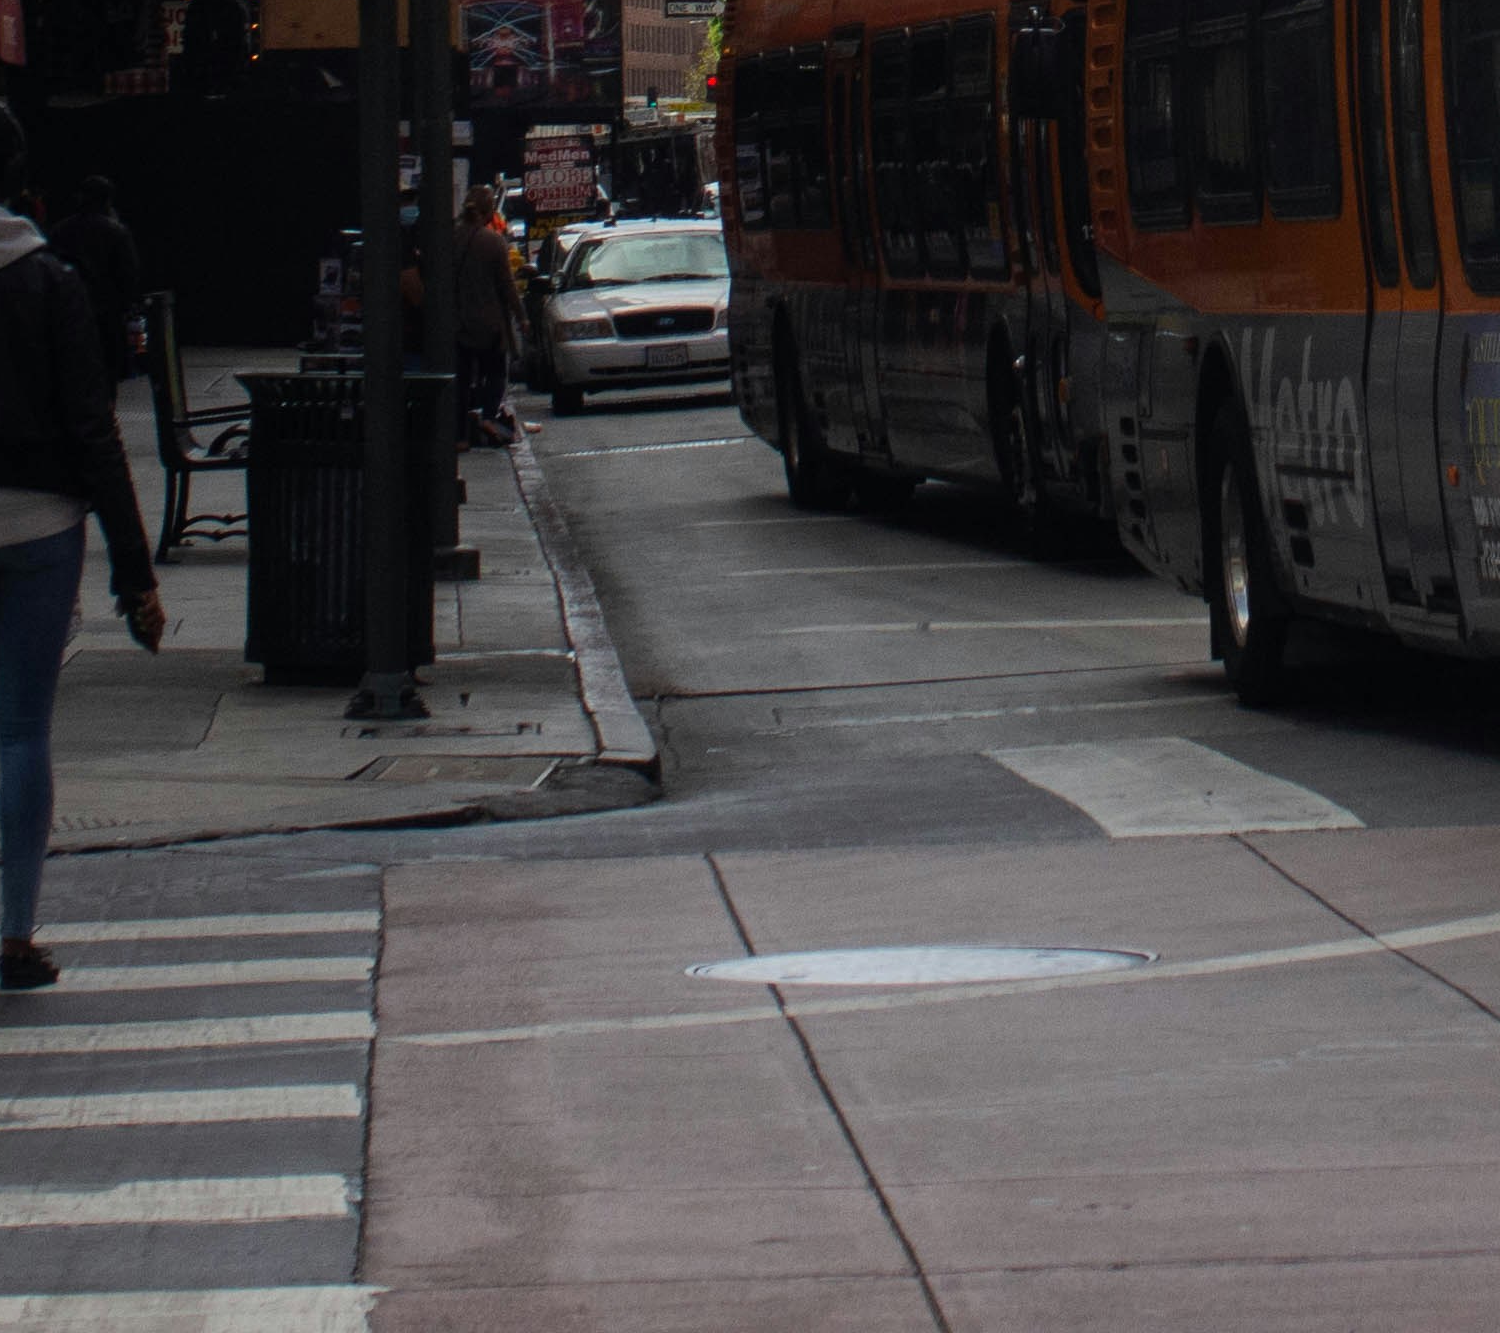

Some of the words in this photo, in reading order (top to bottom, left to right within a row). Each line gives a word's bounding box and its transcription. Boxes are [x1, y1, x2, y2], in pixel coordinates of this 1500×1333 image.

[668, 3, 690, 14] ONE
[693, 3, 715, 14] WAY
[524, 149, 591, 165] MedMen
[524, 166, 593, 183] GLOBE
[526, 185, 592, 202] ORPHEUM
